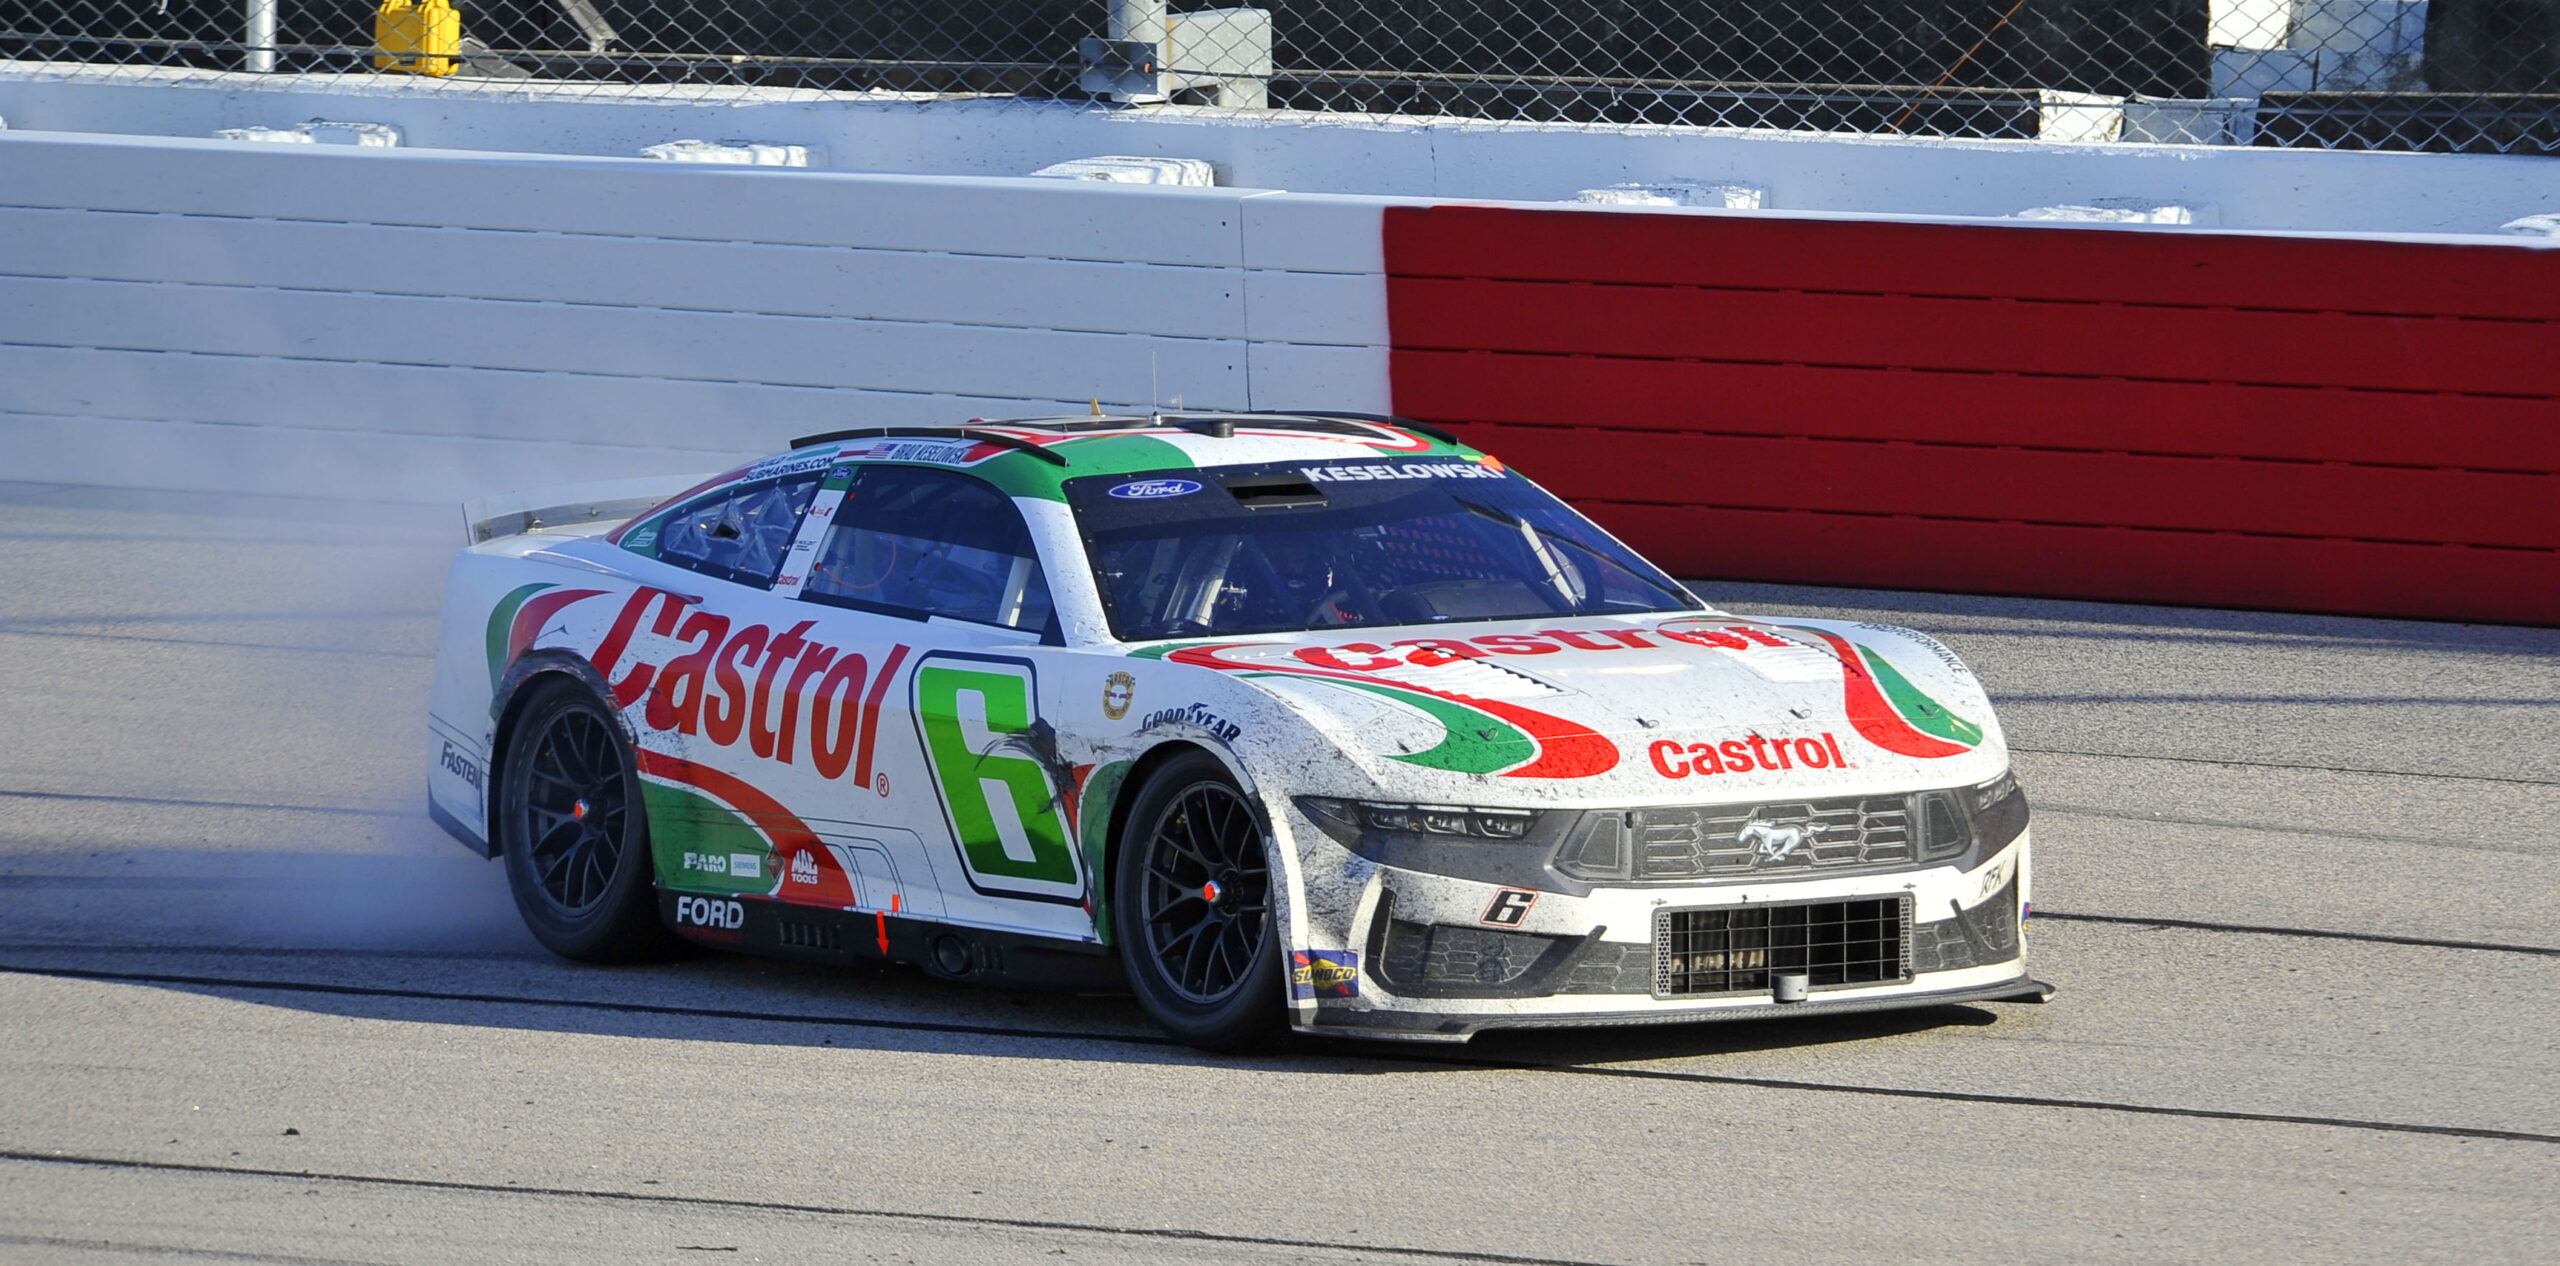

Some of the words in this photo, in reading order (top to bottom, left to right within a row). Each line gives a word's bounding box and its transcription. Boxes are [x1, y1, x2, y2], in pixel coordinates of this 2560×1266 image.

[743, 456, 836, 482] SUBMARINES.COM
[1300, 464, 1507, 482] KESELOWSKI
[1127, 480, 1185, 497] Ford
[589, 586, 911, 790] Castrol
[1648, 732, 1848, 779] Castrol
[917, 665, 1080, 886] 6
[791, 848, 818, 875] MAC
[791, 873, 818, 885] TOOLS
[676, 895, 745, 930] FORD
[1482, 890, 1537, 926] 6
[1293, 966, 1357, 983] SUNOCO
